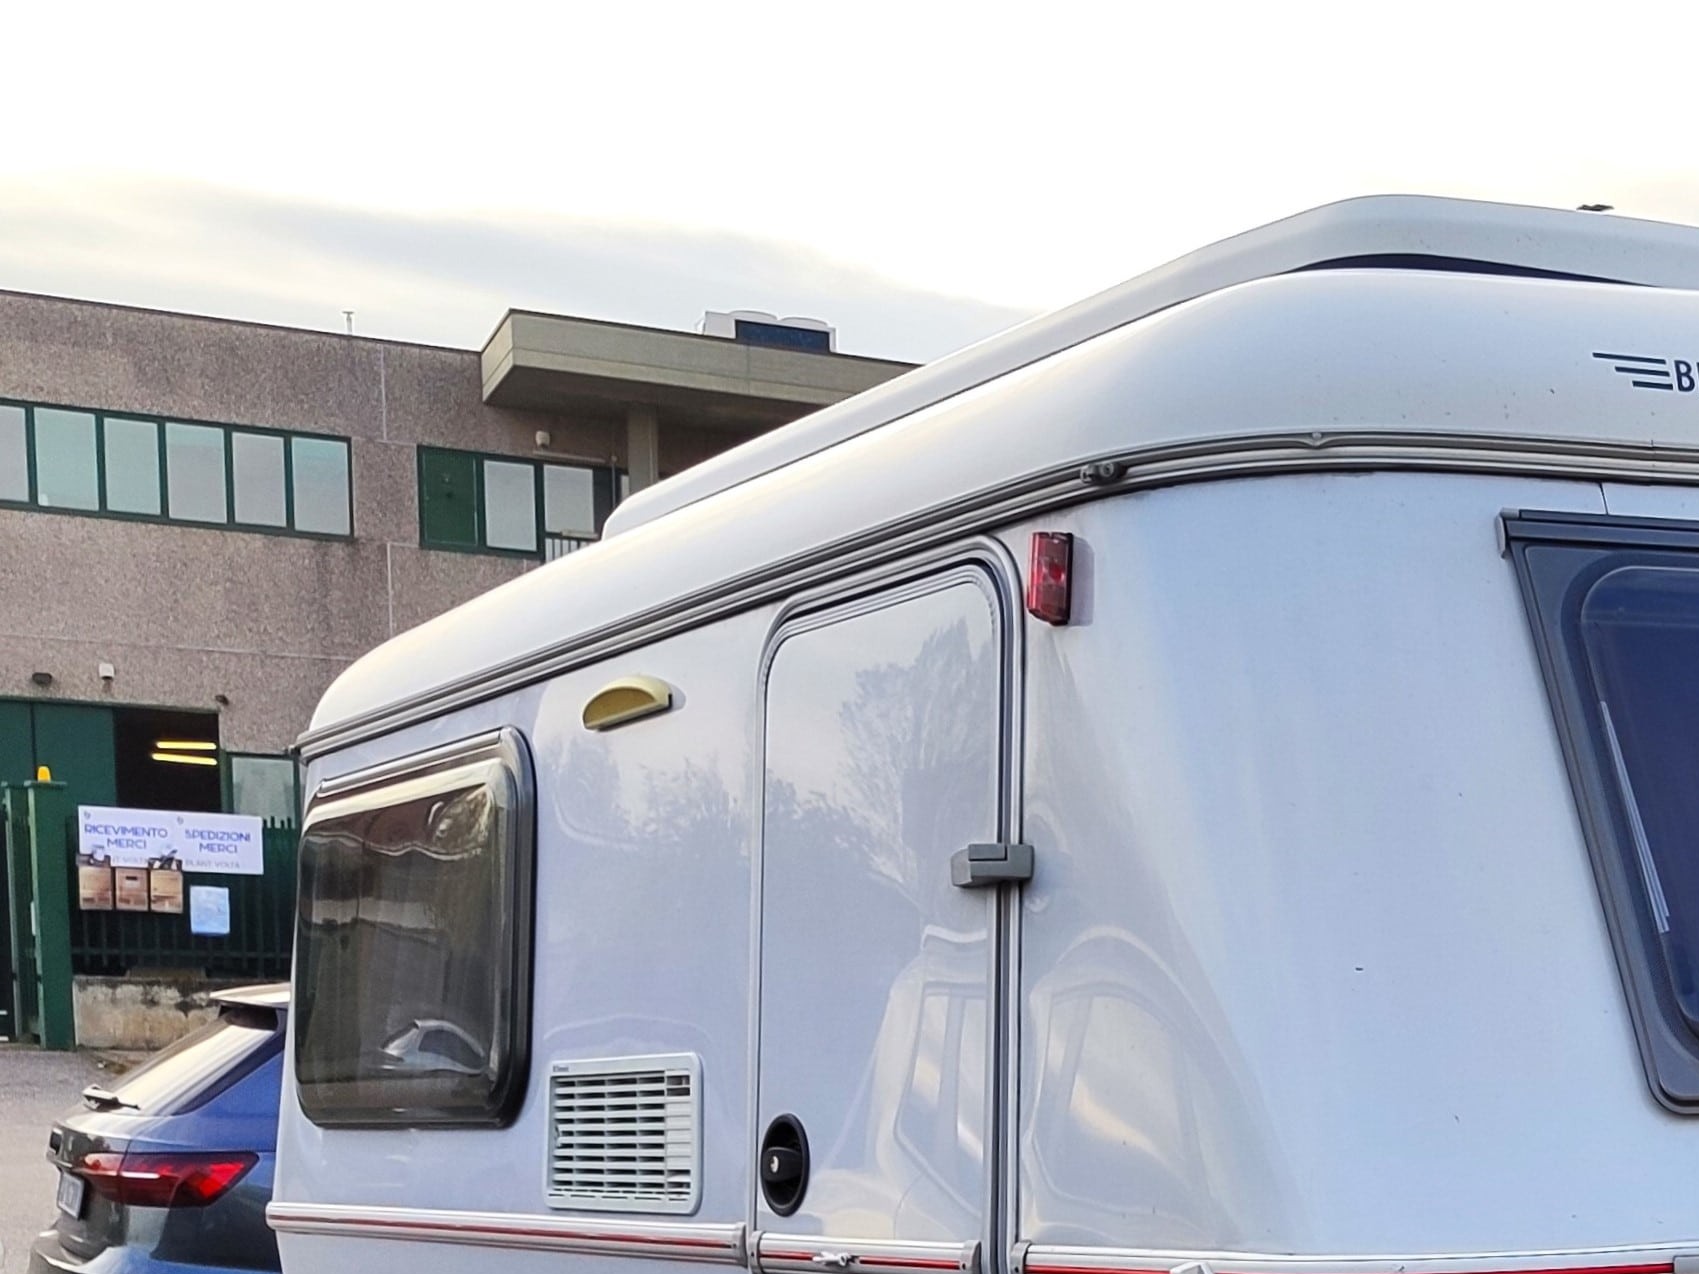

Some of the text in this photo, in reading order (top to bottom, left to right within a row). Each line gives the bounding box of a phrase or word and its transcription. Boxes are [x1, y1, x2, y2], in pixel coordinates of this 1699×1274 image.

[84, 823, 168, 839] RICEVIMENTO
[184, 828, 251, 843] SPEDIZIONI
[106, 838, 147, 850] MERCI
[199, 842, 238, 854] MERCI
